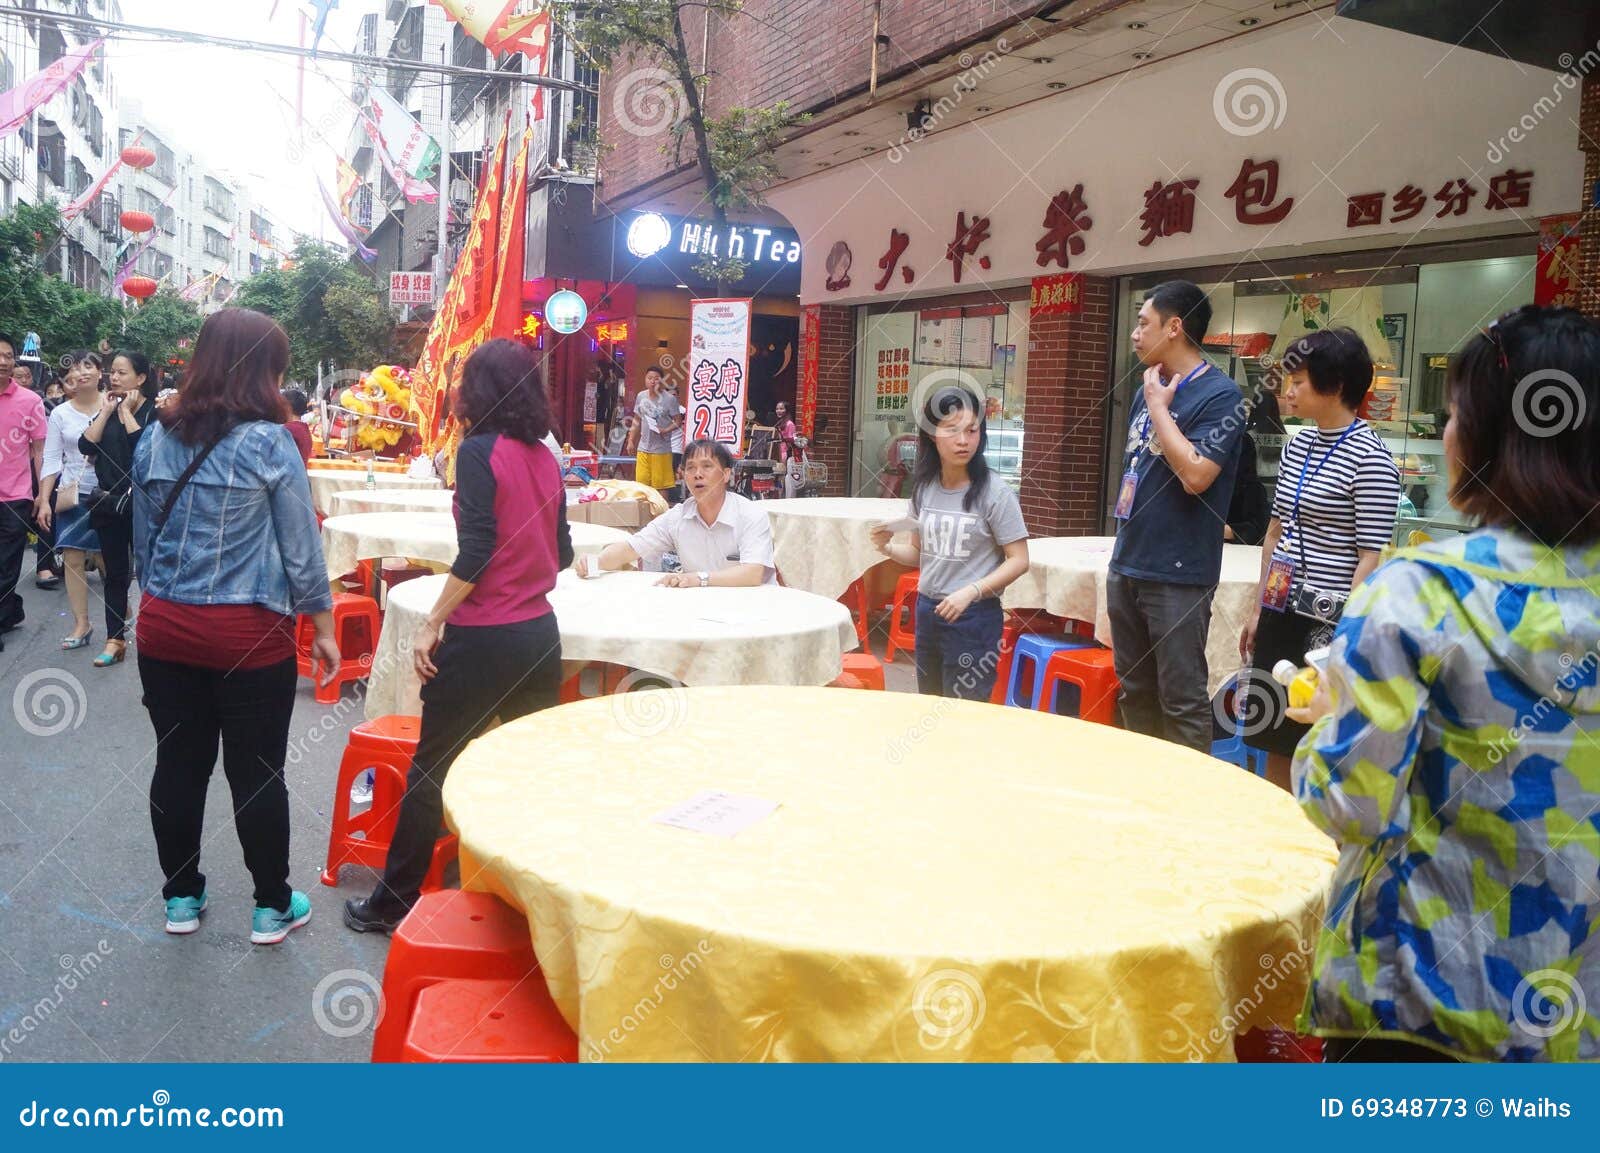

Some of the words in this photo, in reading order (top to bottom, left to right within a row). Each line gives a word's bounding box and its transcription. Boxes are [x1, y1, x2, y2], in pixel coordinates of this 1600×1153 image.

[1346, 168, 1535, 228] 西乡分店
[752, 228, 802, 263] Tea
[692, 358, 743, 404] 宴席
[693, 404, 738, 444] 2區
